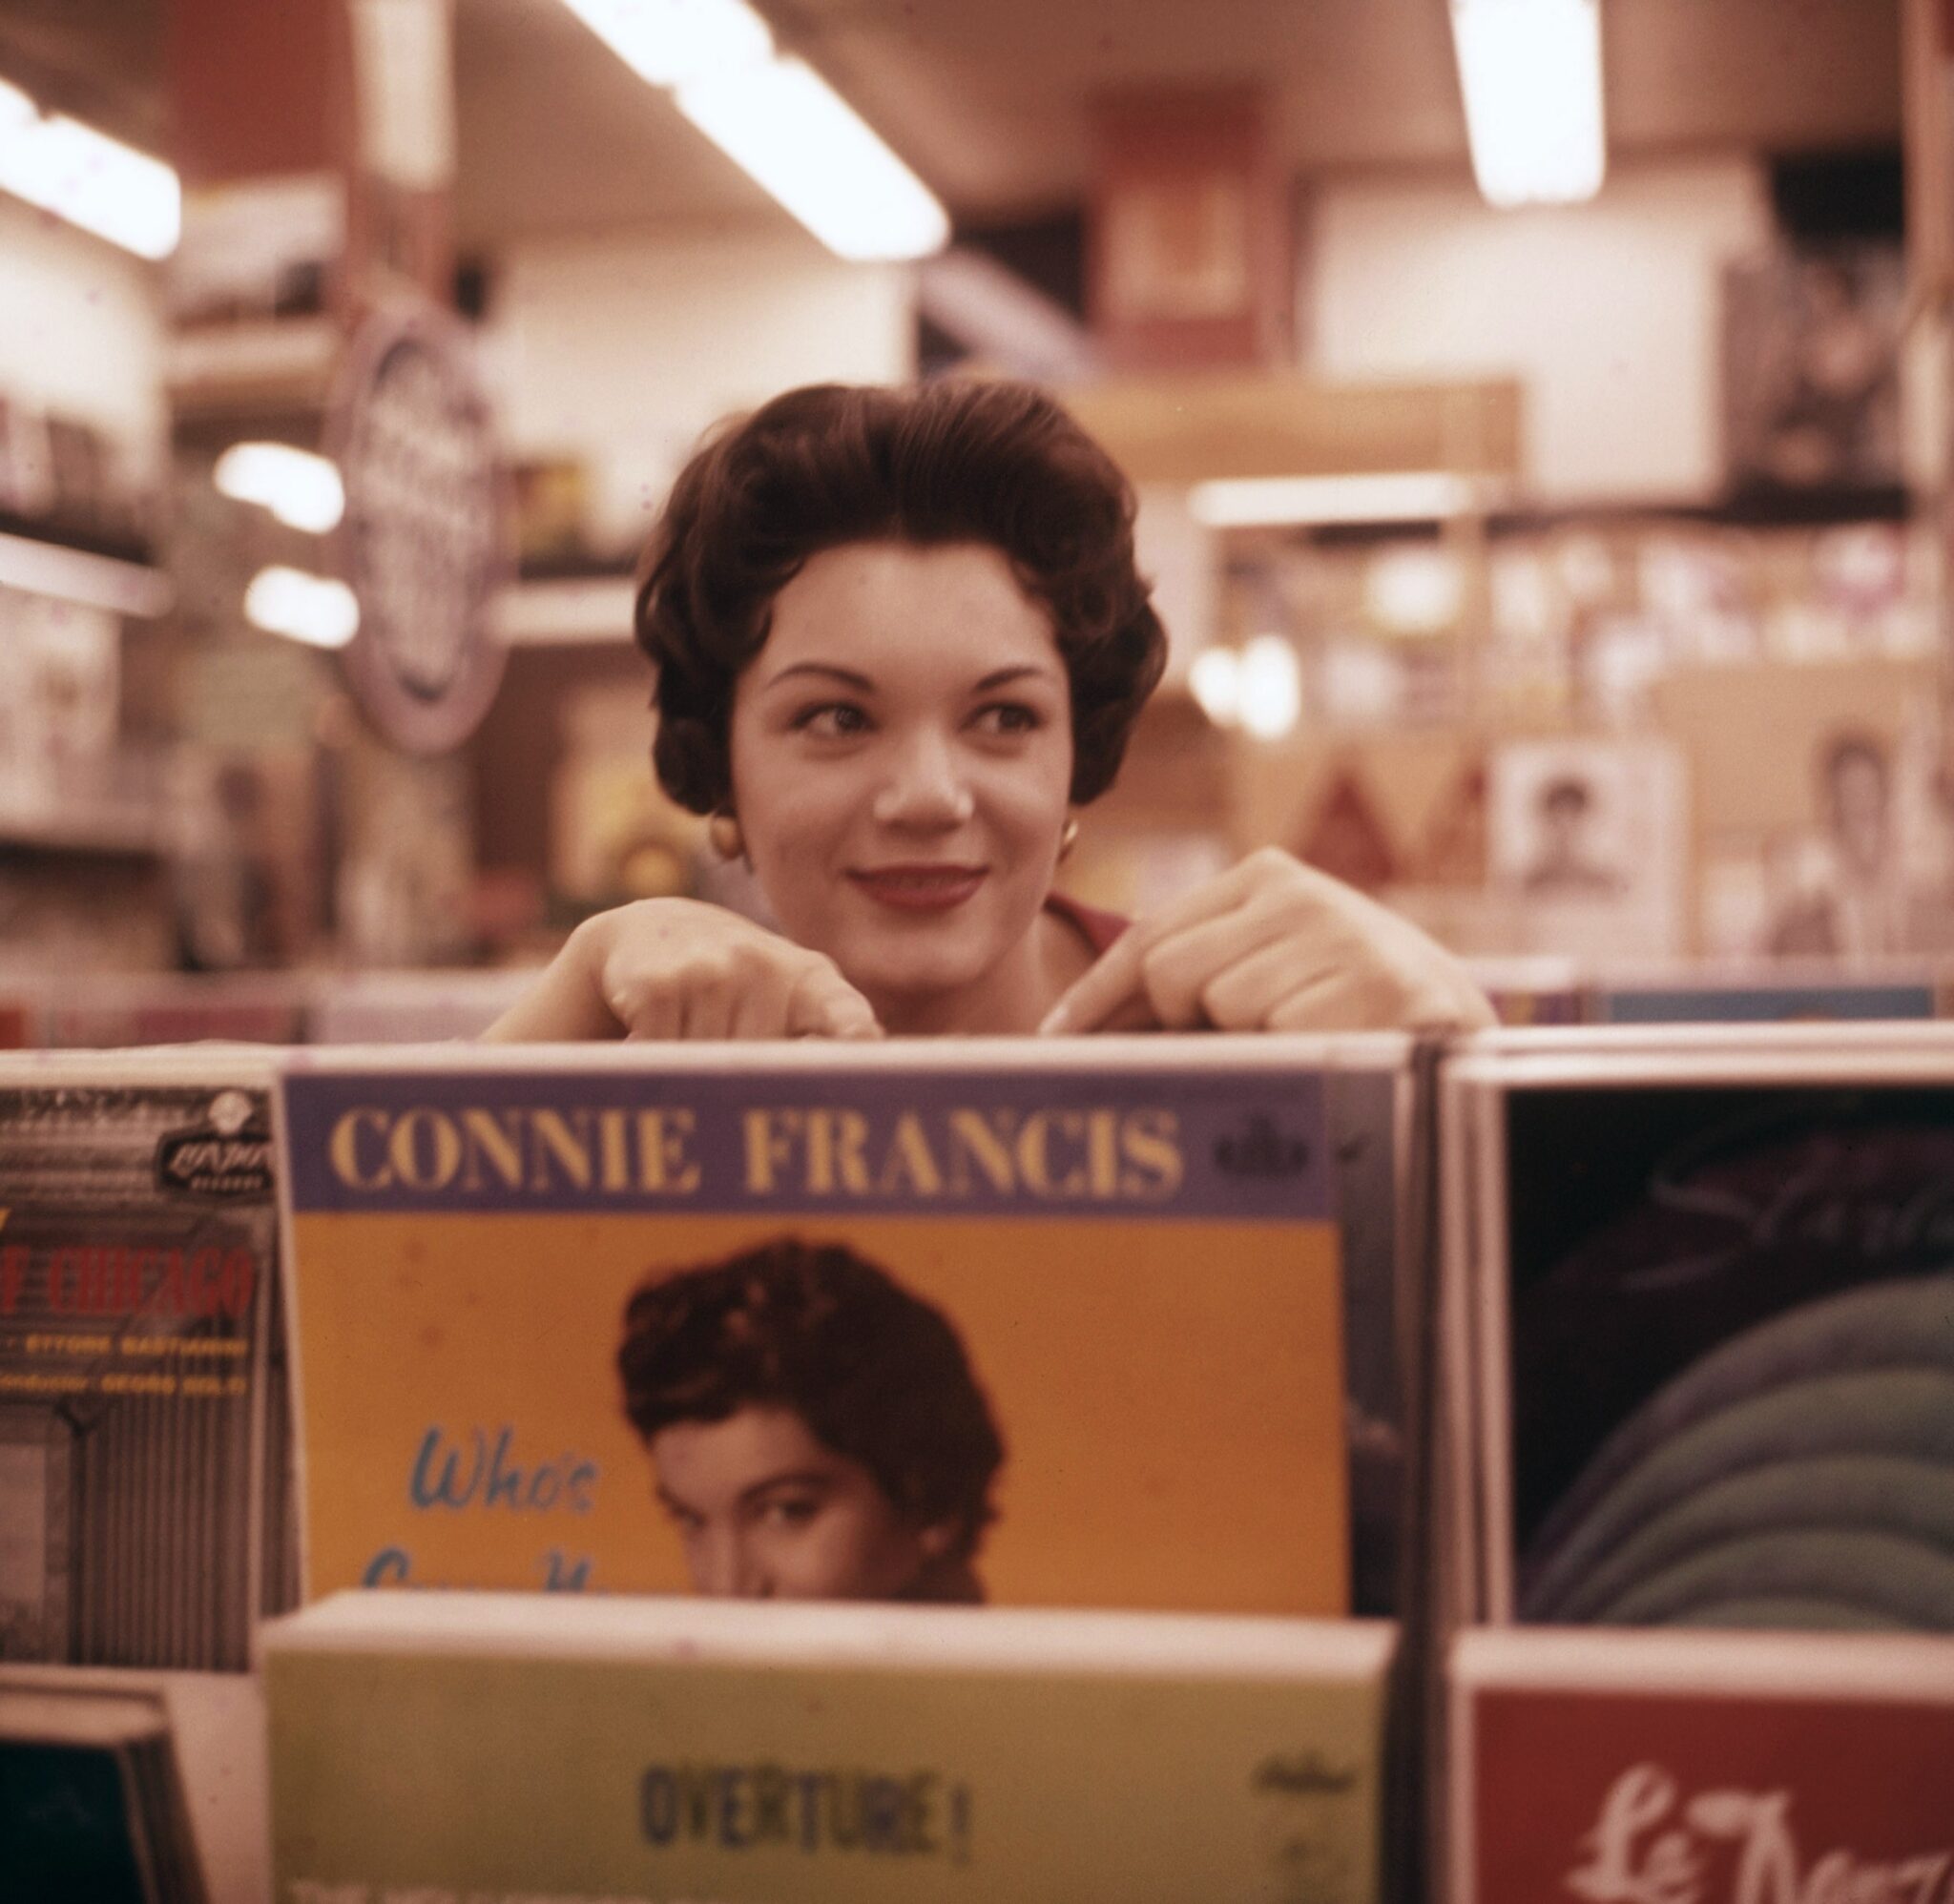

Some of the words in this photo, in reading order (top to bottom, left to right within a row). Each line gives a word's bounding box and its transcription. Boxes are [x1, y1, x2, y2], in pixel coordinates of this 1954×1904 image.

[329, 1107, 701, 1192] CONNIE
[743, 1107, 1184, 1199] FRANCIS
[50, 1245, 256, 1318] CHICAGO
[639, 1762, 971, 1864] OVERTURE!
